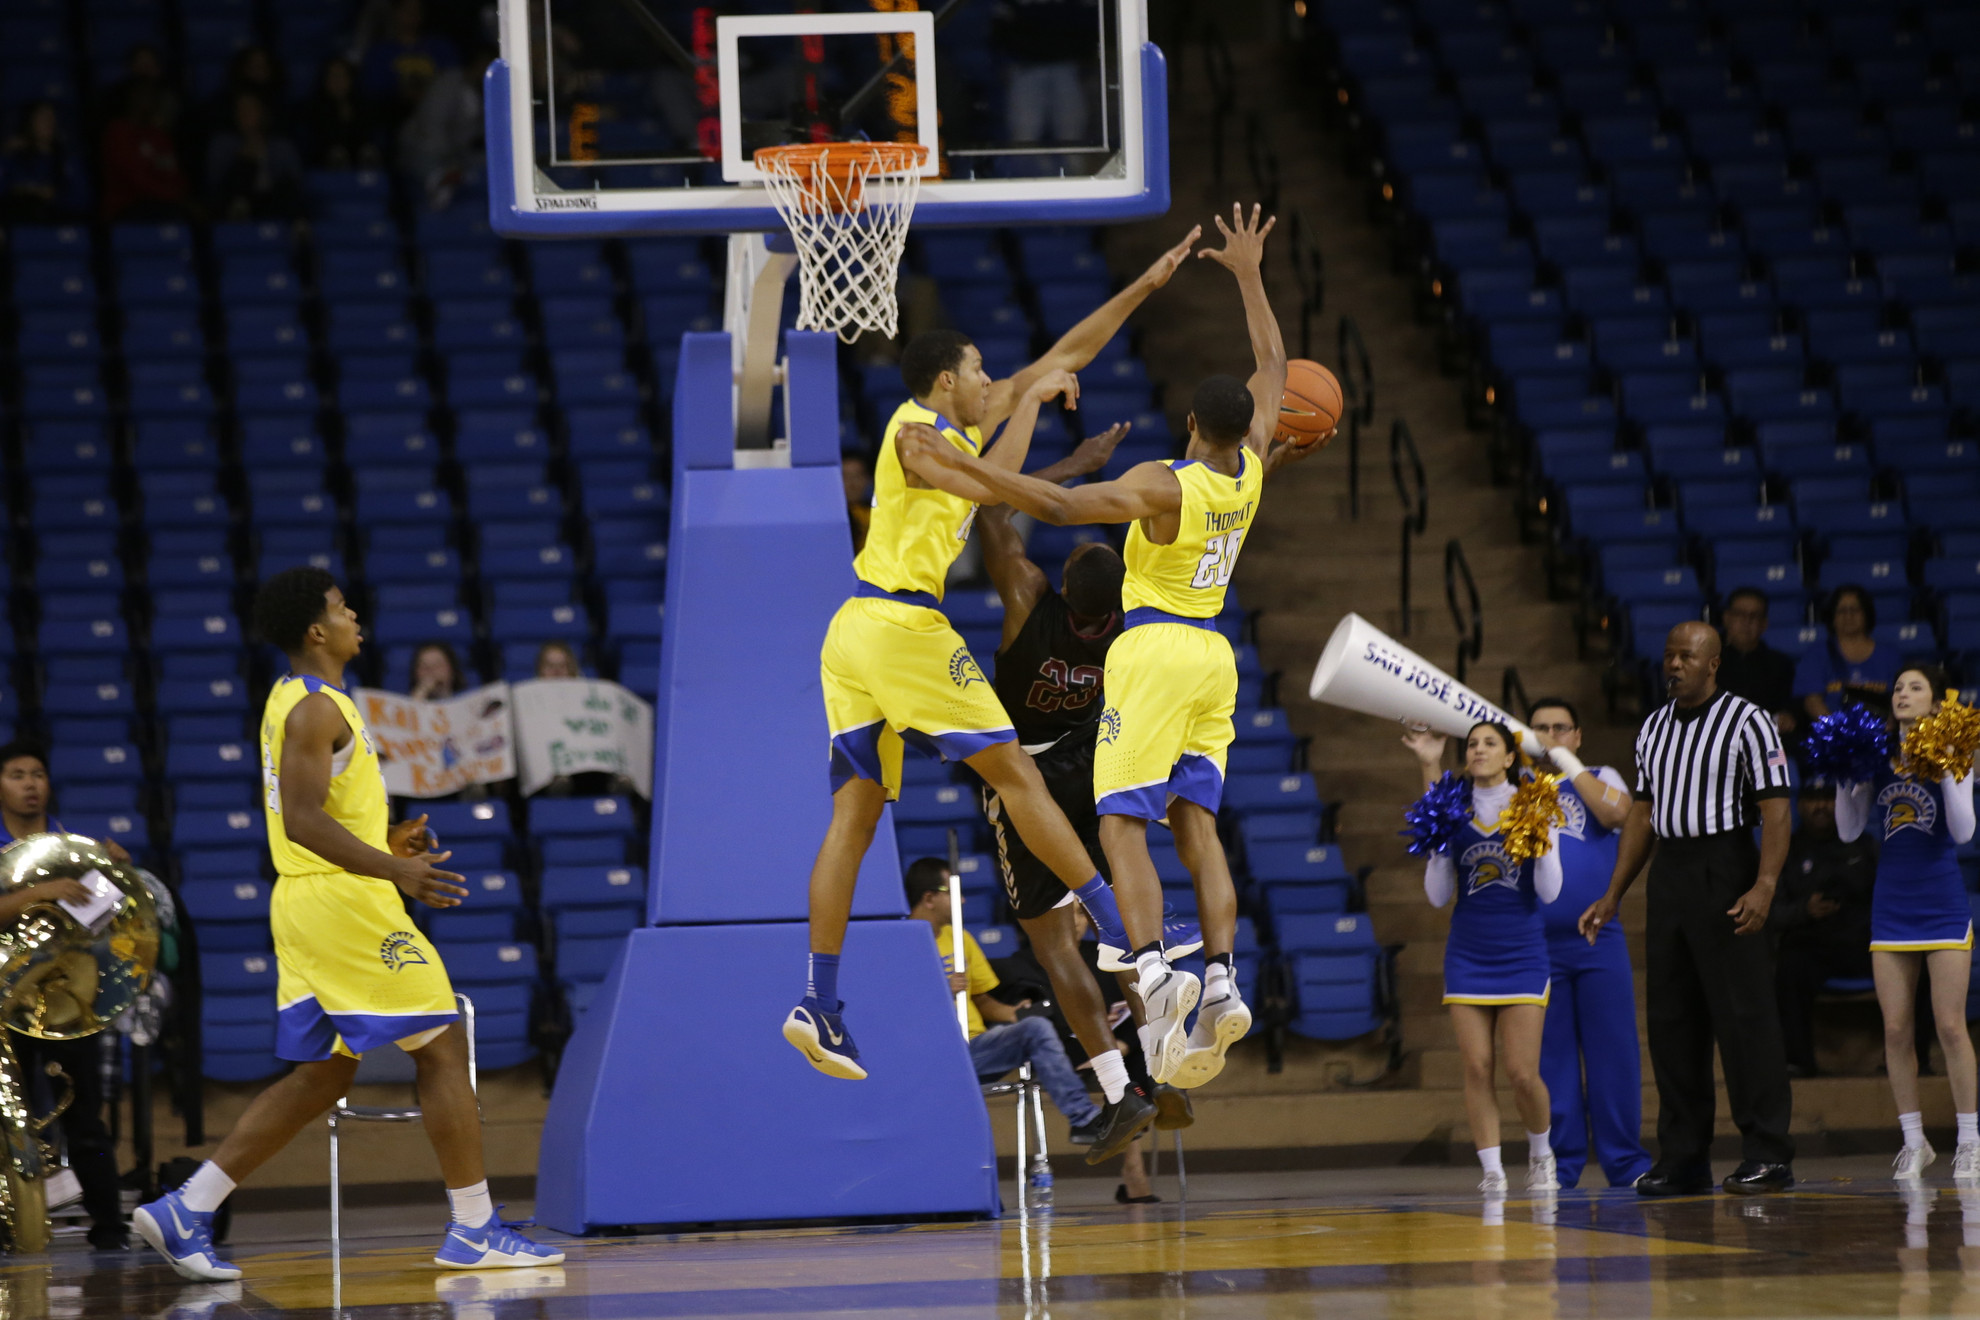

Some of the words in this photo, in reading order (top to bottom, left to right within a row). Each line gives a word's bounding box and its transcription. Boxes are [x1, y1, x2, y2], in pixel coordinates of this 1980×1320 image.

[535, 197, 598, 212] SPALDING
[1190, 527, 1245, 589] 20
[1363, 641, 1405, 677] SAN
[1025, 656, 1105, 713] 23
